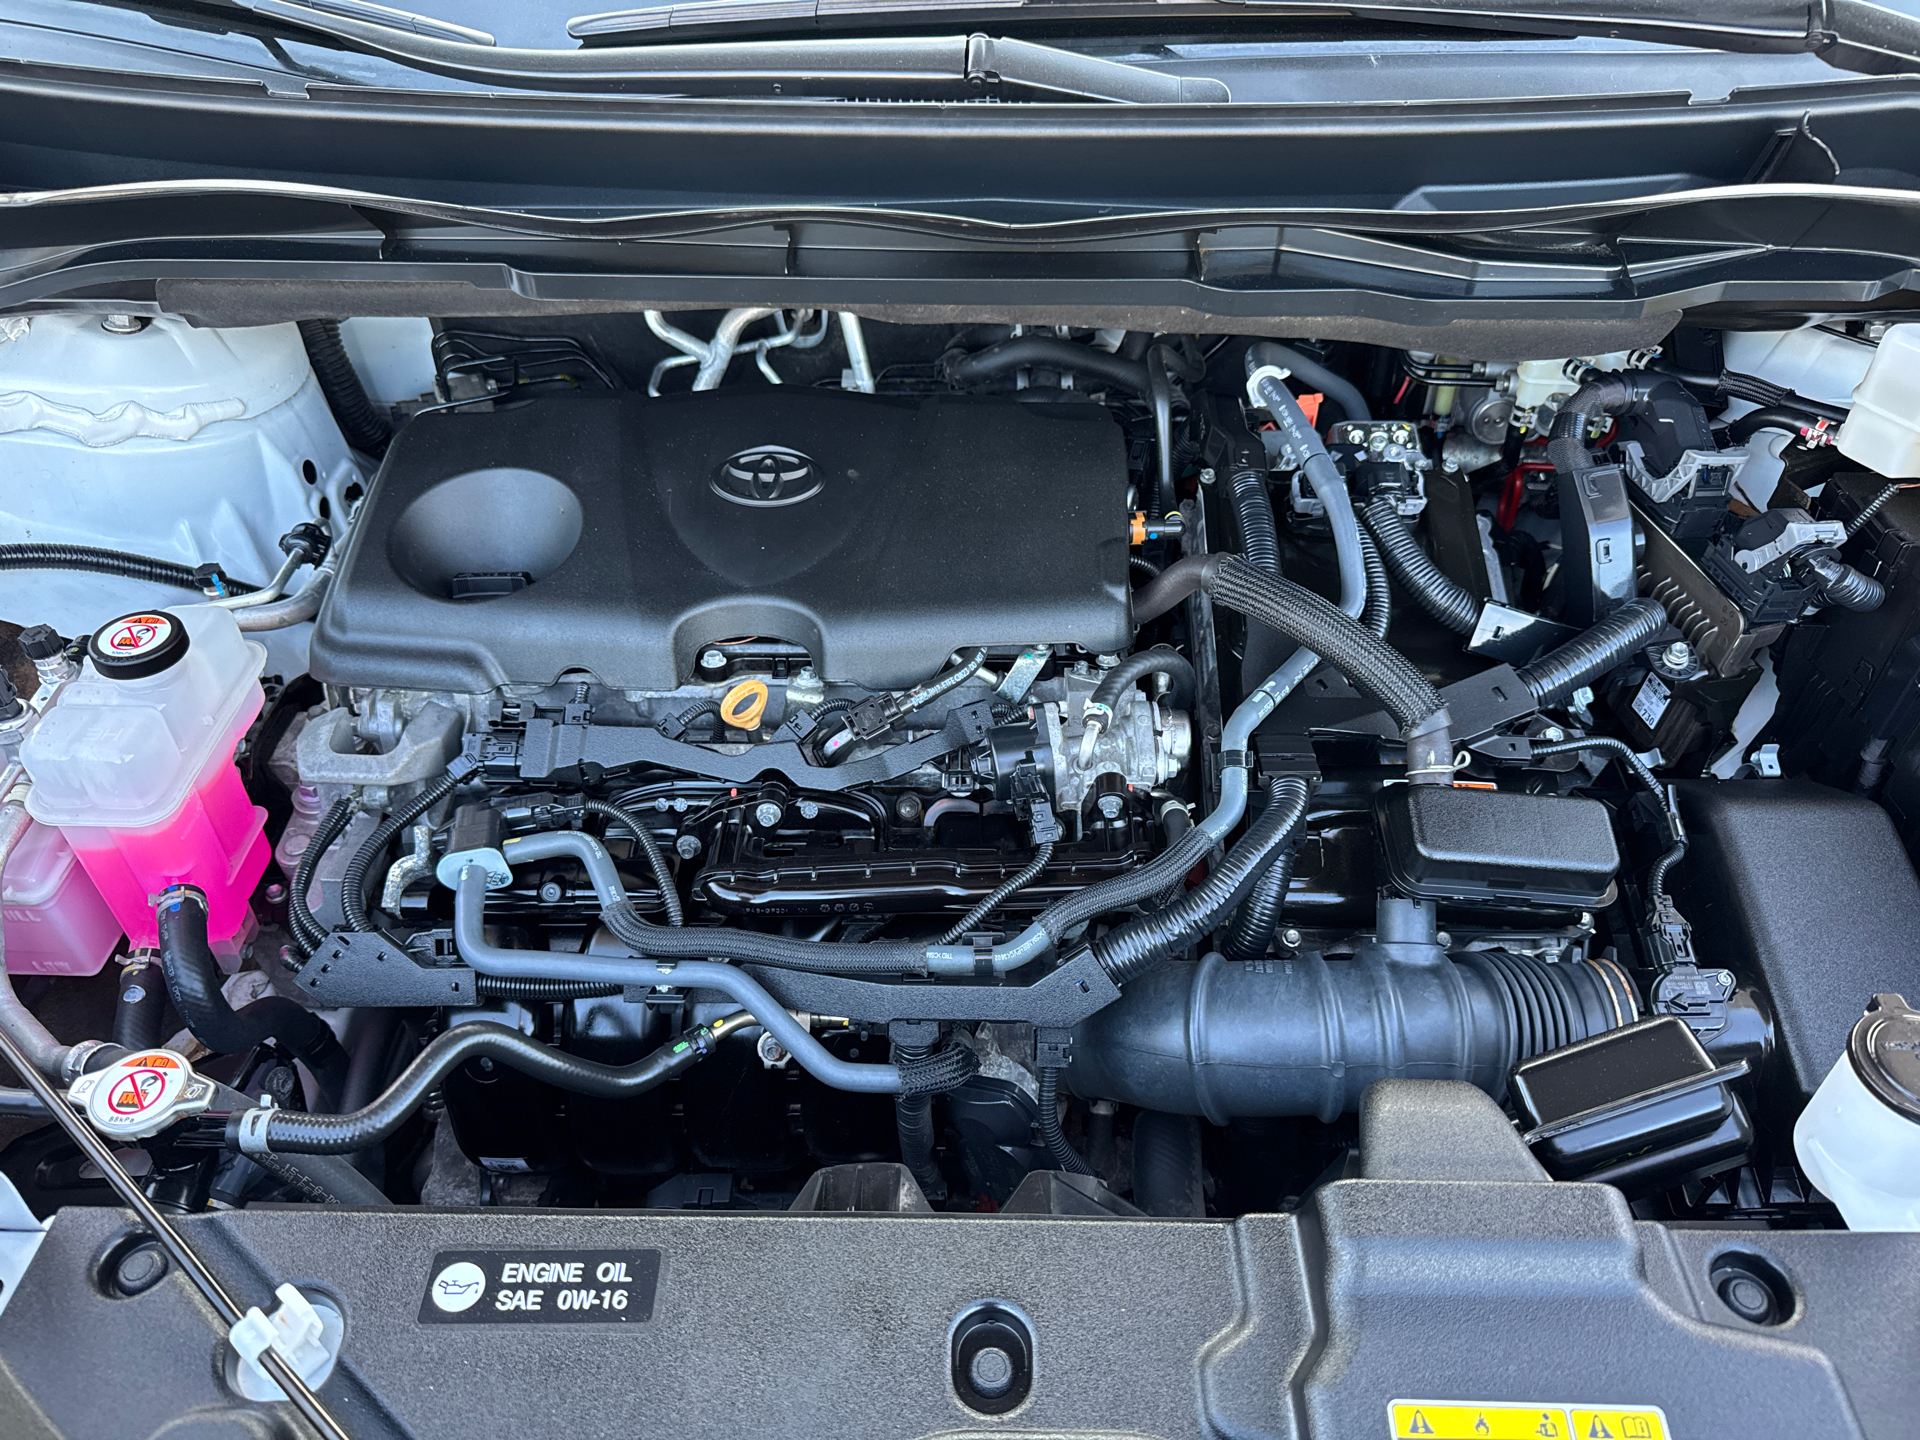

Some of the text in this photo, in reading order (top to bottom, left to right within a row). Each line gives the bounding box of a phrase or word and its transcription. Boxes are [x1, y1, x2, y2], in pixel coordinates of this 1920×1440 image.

[1641, 709, 1655, 726] 730
[31, 961, 72, 973] LOW
[108, 1115, 135, 1123] 88kPa
[501, 1262, 632, 1283] ENGINE OIL
[495, 1289, 629, 1311] SAE 0W-16
